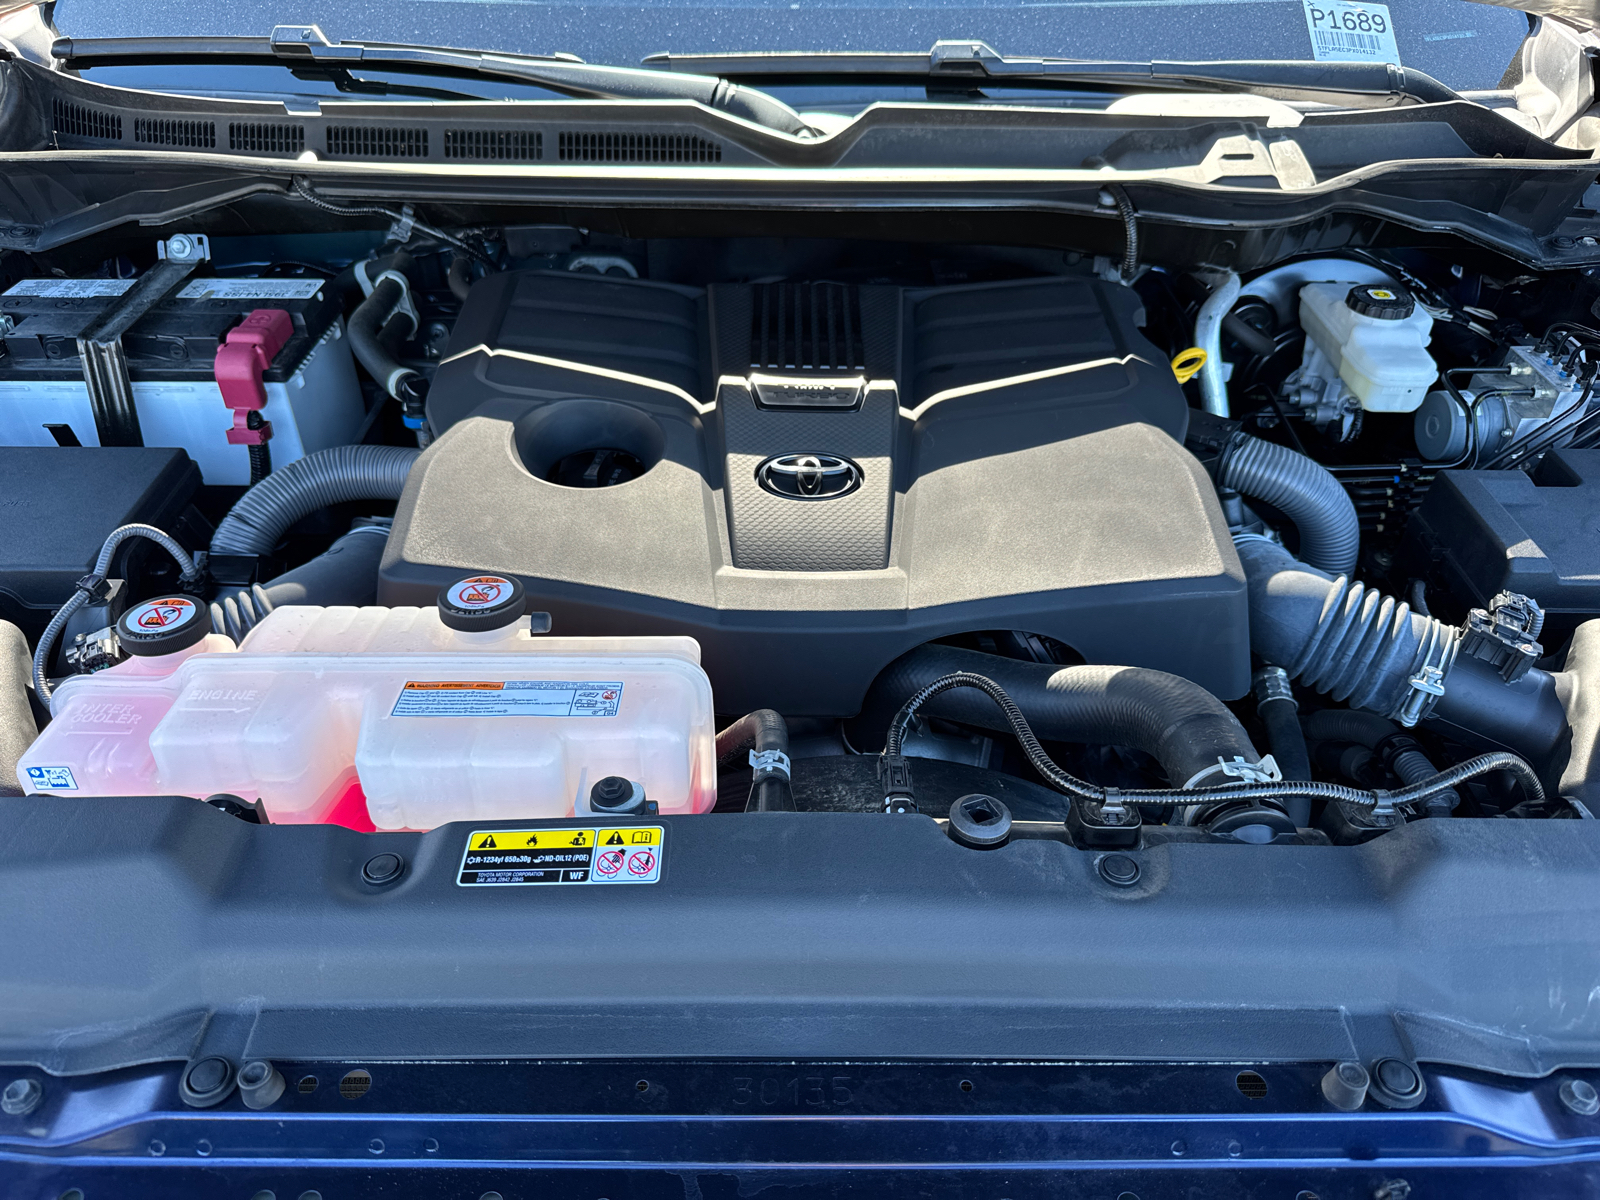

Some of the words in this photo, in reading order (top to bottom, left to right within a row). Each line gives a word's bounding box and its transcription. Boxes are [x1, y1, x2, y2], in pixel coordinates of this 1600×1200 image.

[1310, 8, 1387, 34] P1689
[188, 689, 259, 701] ENGINE
[78, 703, 135, 714] INTER
[71, 713, 143, 725] COOLER
[504, 854, 532, 864] 650±30g
[572, 854, 590, 863] (POE)
[569, 872, 585, 880] WF
[733, 1076, 852, 1106] 30135
